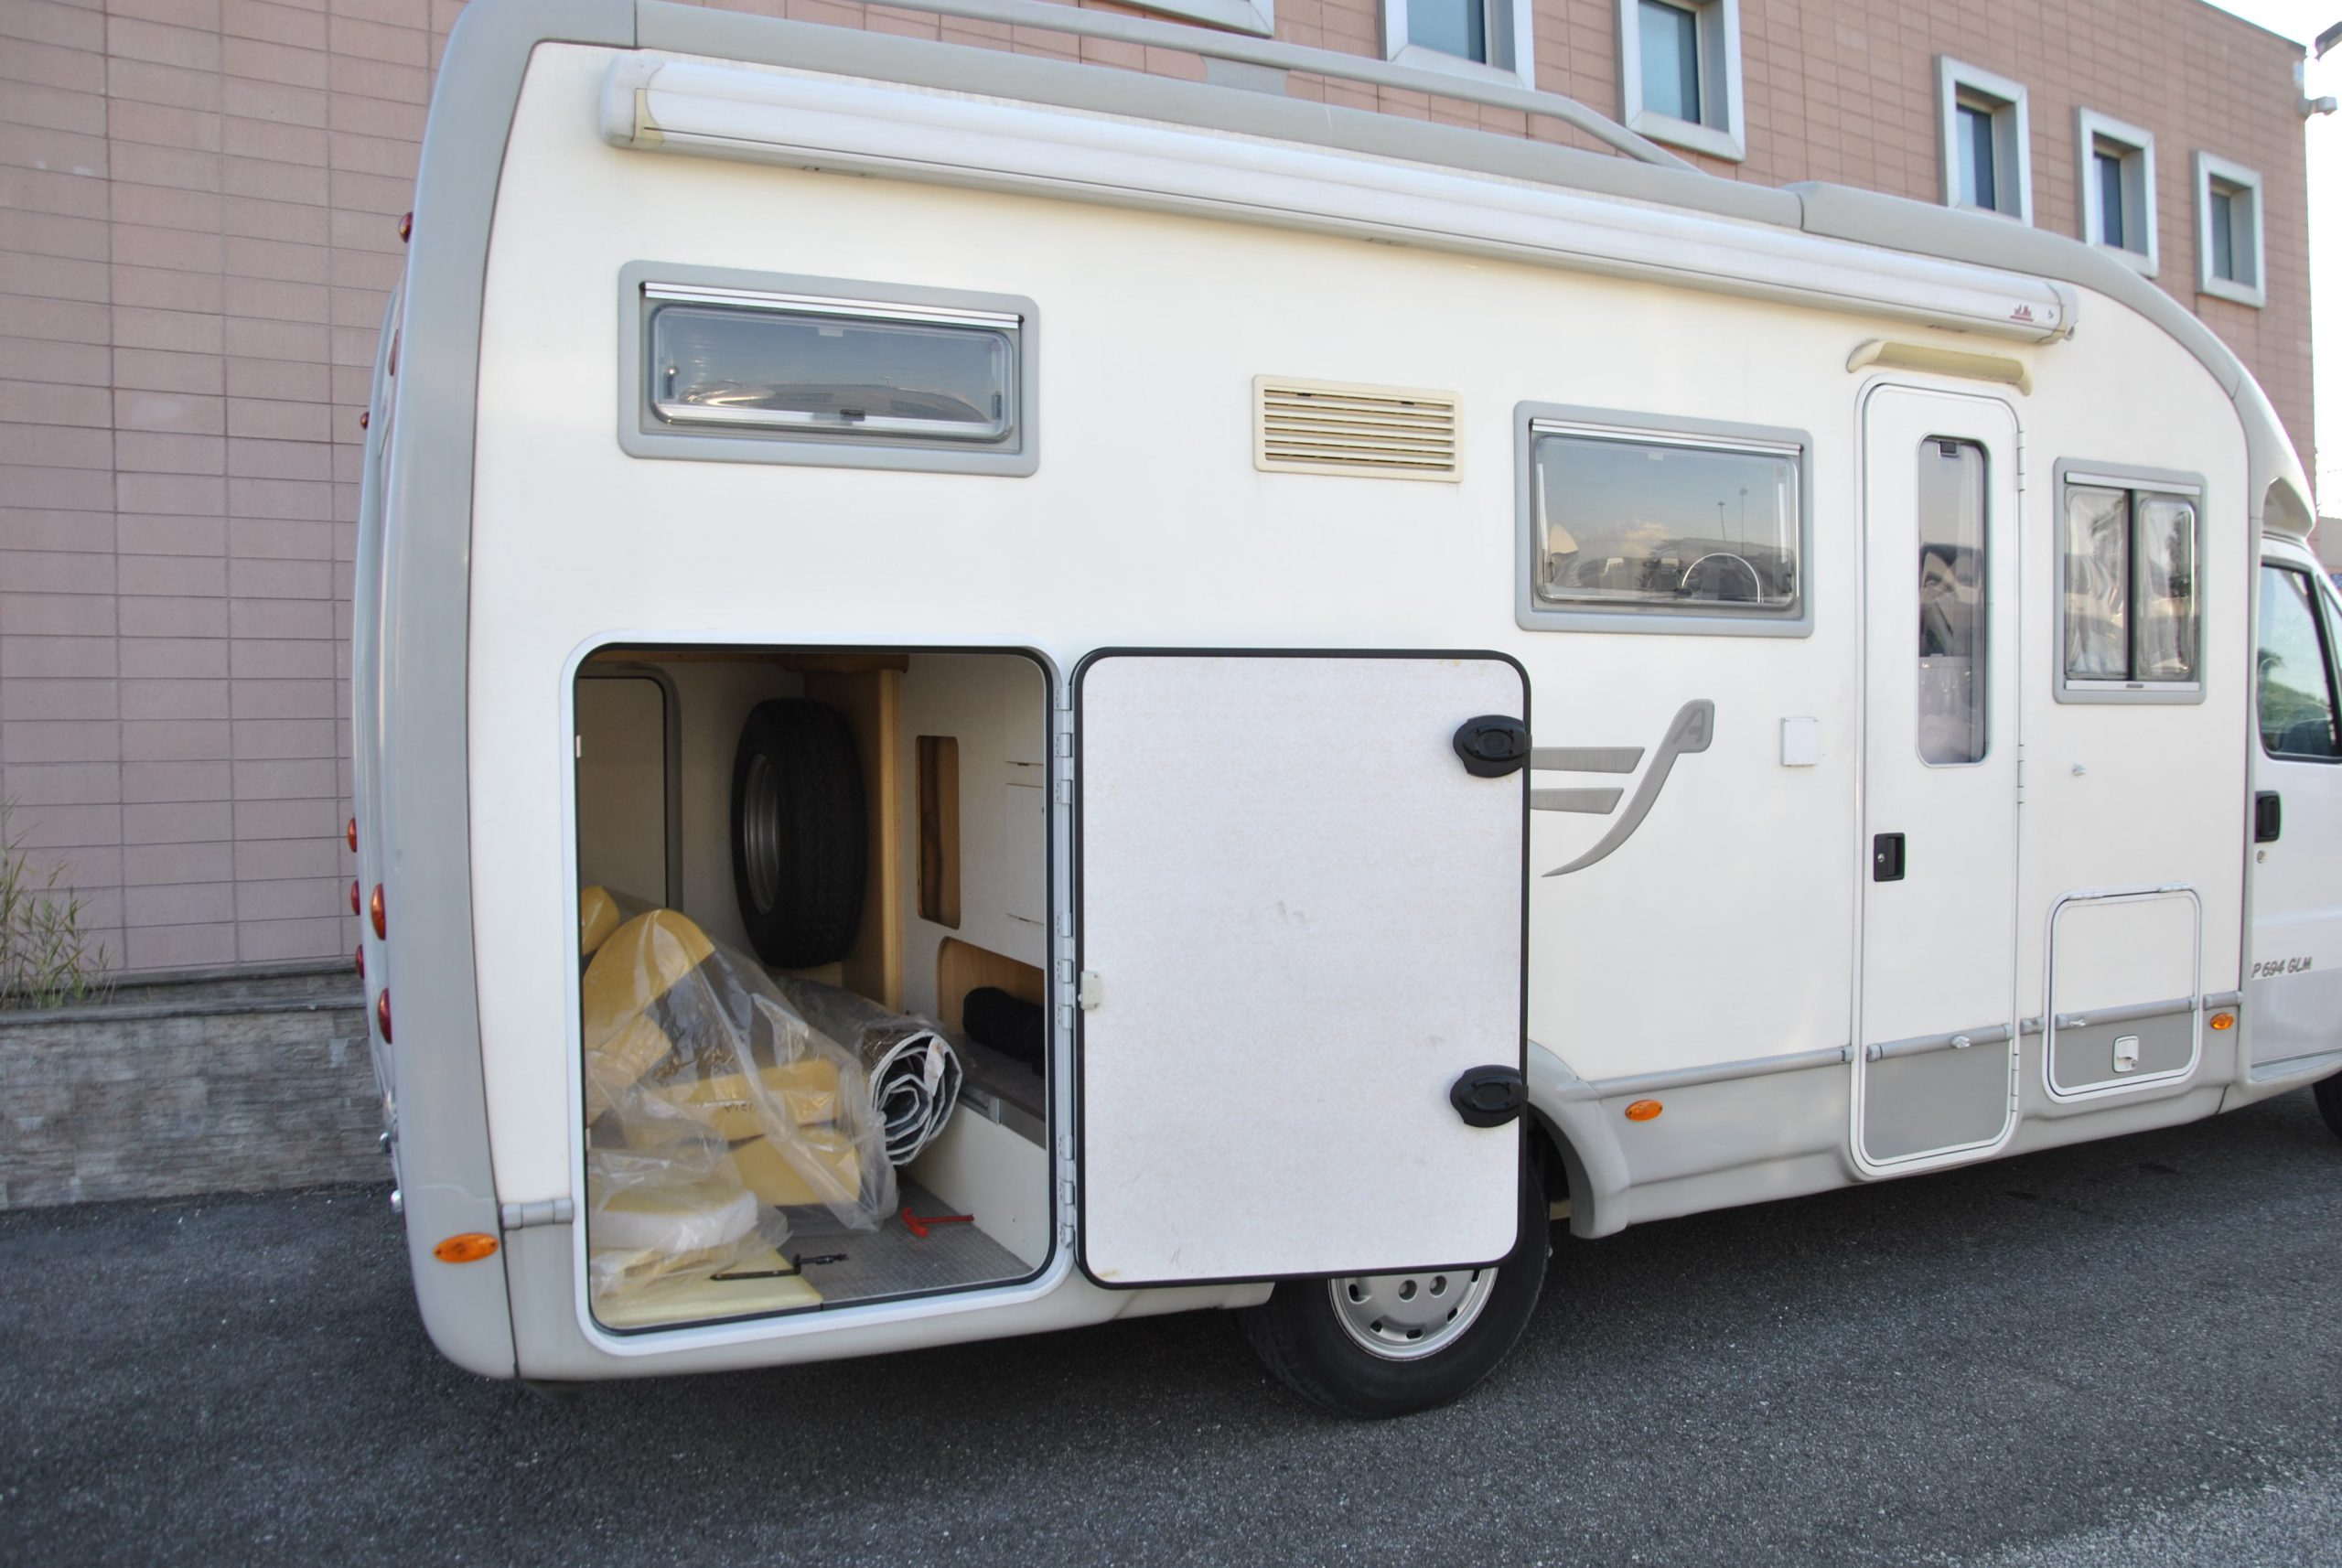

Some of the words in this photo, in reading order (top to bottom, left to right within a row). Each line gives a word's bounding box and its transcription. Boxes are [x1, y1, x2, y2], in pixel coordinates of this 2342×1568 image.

[2251, 962, 2261, 978] P
[2261, 959, 2285, 977] 694
[2287, 956, 2313, 973] GLM
